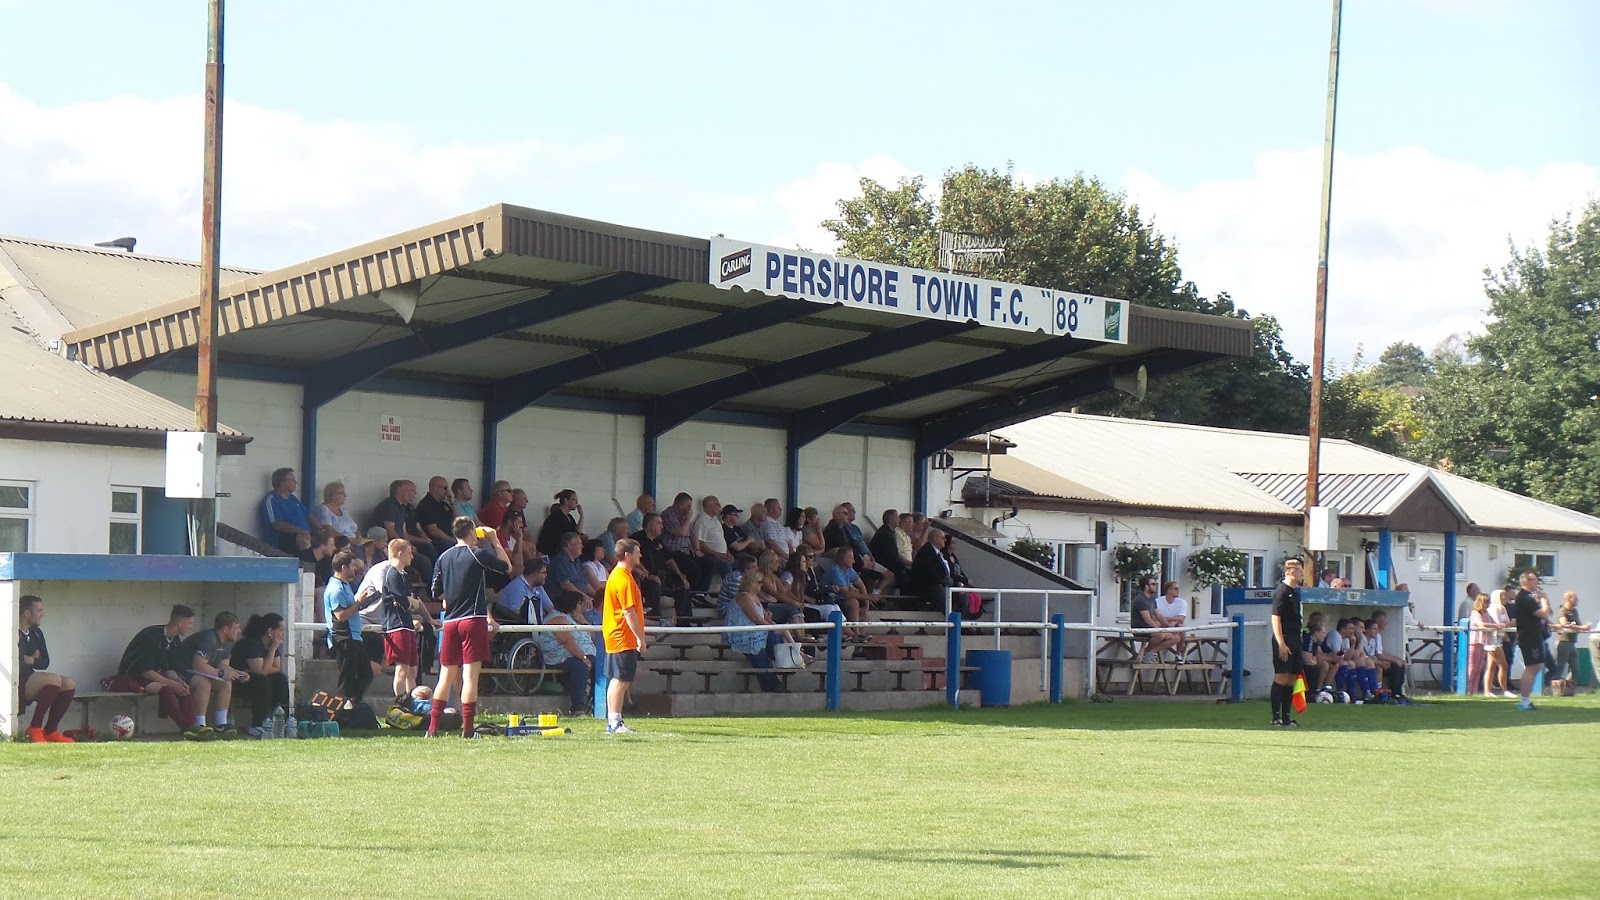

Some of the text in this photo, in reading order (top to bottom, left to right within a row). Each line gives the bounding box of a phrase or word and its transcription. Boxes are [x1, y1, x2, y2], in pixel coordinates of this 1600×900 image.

[721, 254, 751, 277] CARLING
[766, 251, 898, 307] PERSHORE
[912, 274, 978, 318] TOWN
[990, 286, 1029, 326] F.C.
[1254, 590, 1272, 598] HOME
